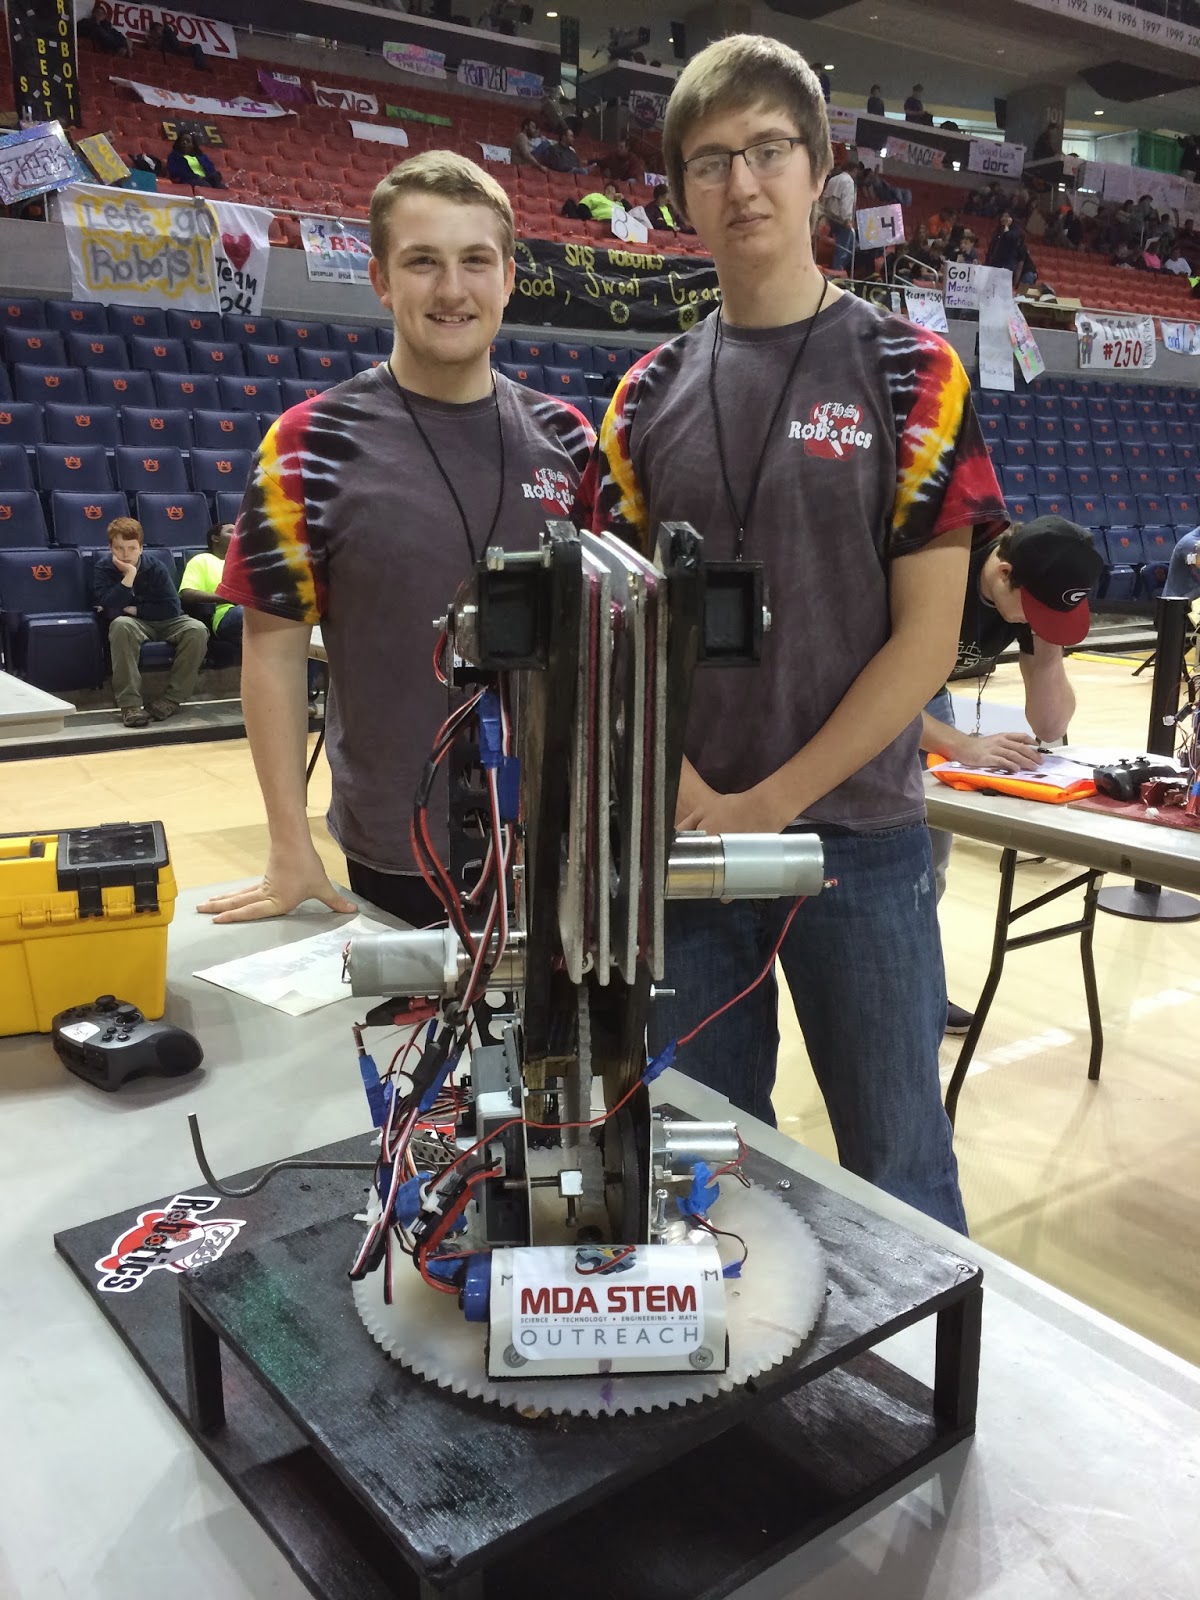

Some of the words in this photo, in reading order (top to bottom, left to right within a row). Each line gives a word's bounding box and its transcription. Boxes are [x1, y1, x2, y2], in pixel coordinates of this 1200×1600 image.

[1093, 4, 1112, 20] 1994
[1142, 19, 1161, 34] 1997
[1166, 26, 1184, 42] 1999
[57, 0, 74, 120] ROBOTI
[668, 271, 722, 304] Gear
[1103, 340, 1142, 368] #250
[788, 420, 873, 449] Robotics
[520, 1286, 599, 1315] MDA
[607, 1285, 697, 1313] STEM
[520, 1326, 699, 1346] OUTREACH
